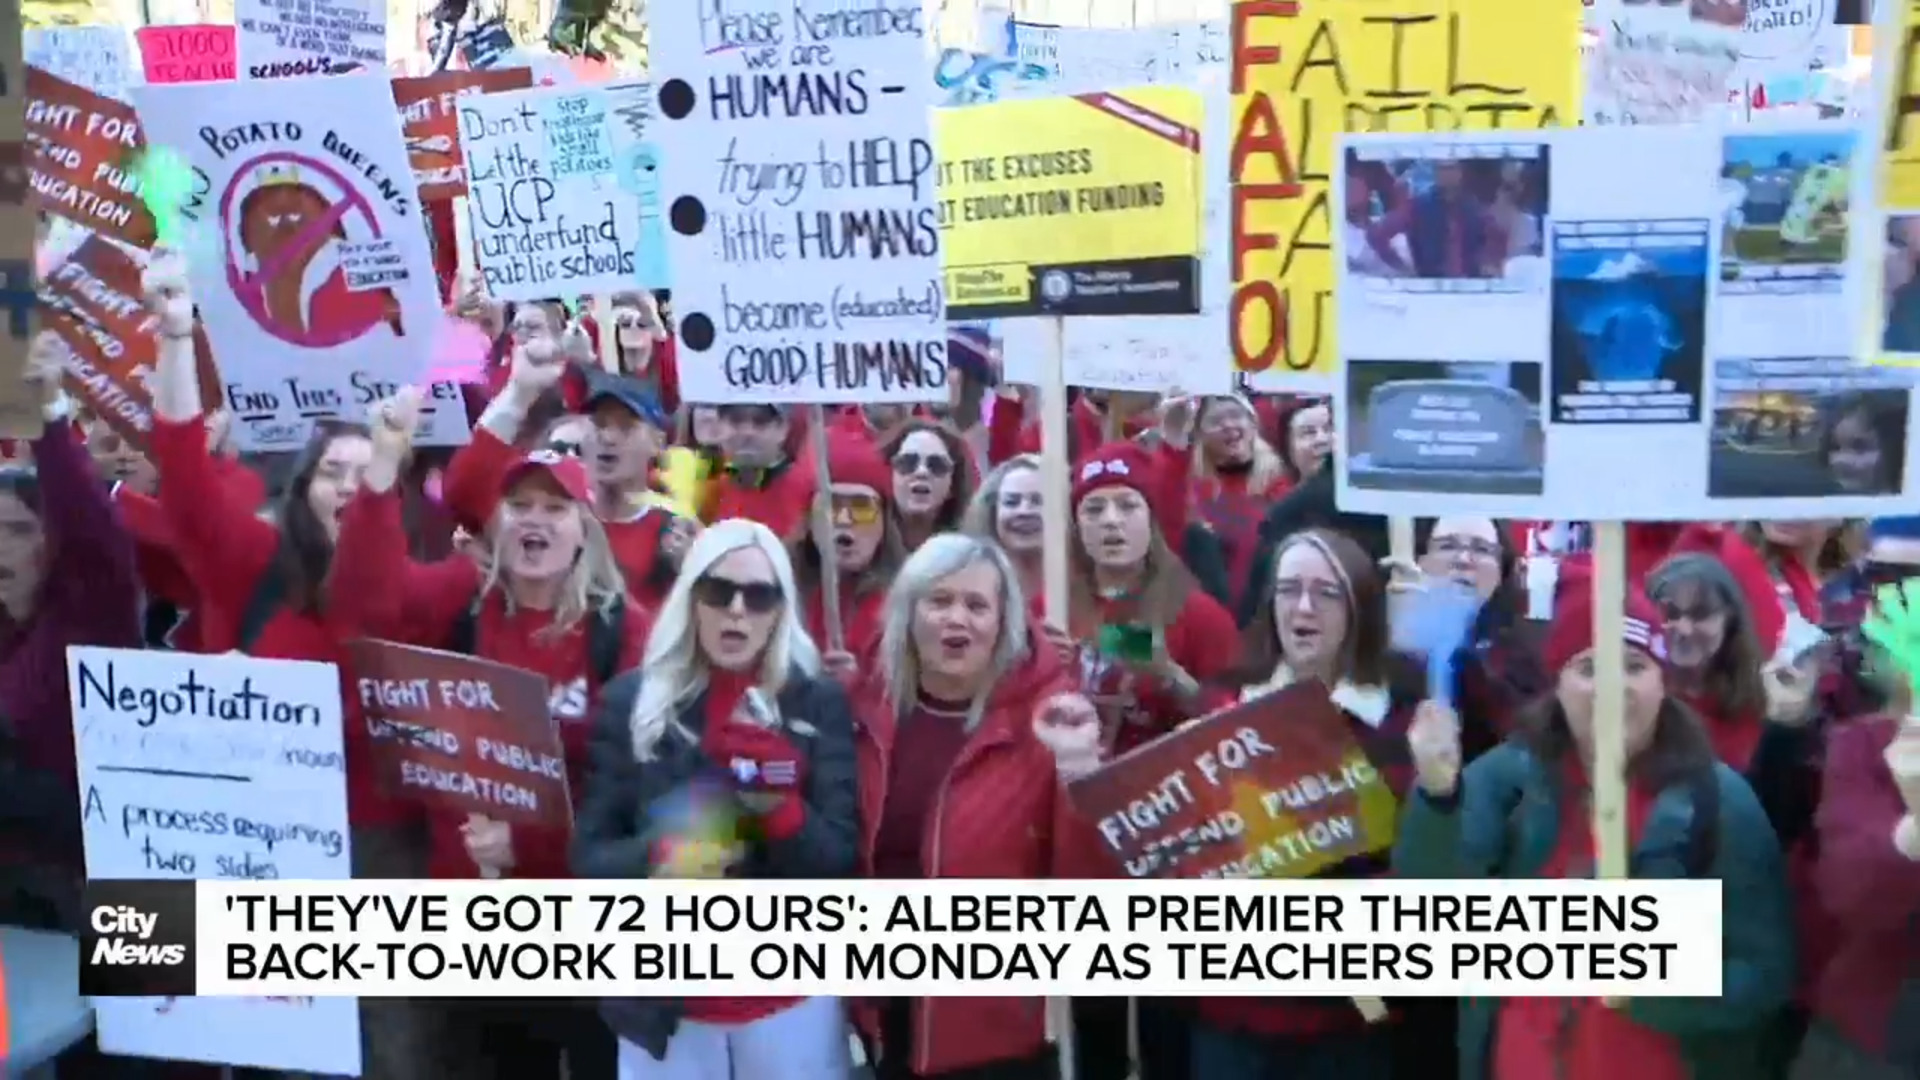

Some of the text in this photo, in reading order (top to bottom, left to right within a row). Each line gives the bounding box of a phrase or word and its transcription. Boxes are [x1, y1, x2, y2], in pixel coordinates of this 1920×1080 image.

[741, 44, 833, 69] we are
[1230, 0, 1527, 96] FAIL
[709, 68, 868, 120] HUMANS
[85, 111, 136, 148] FOR
[849, 137, 933, 200] HELP
[962, 157, 997, 183] THE
[1003, 148, 1093, 181] EXCUSES
[472, 177, 555, 229] UCP
[963, 189, 1071, 223] EDUCATION
[1077, 181, 1165, 214] FUNDING
[481, 201, 620, 257] underfund
[796, 207, 938, 260] HUMANS
[483, 241, 636, 298] public schools
[721, 283, 827, 334] become
[724, 339, 947, 391] GOOD HUMANS
[227, 383, 280, 412] END
[79, 659, 321, 727] Negotiation
[358, 676, 503, 712] FIGHT FOR
[475, 735, 564, 780] PUBLIC
[401, 759, 538, 811] EDUCATION
[1097, 726, 1276, 850] FIGHT FOR
[1259, 758, 1379, 819] PUBLIC
[83, 784, 107, 824] A
[122, 803, 229, 839] process
[140, 834, 197, 875] two
